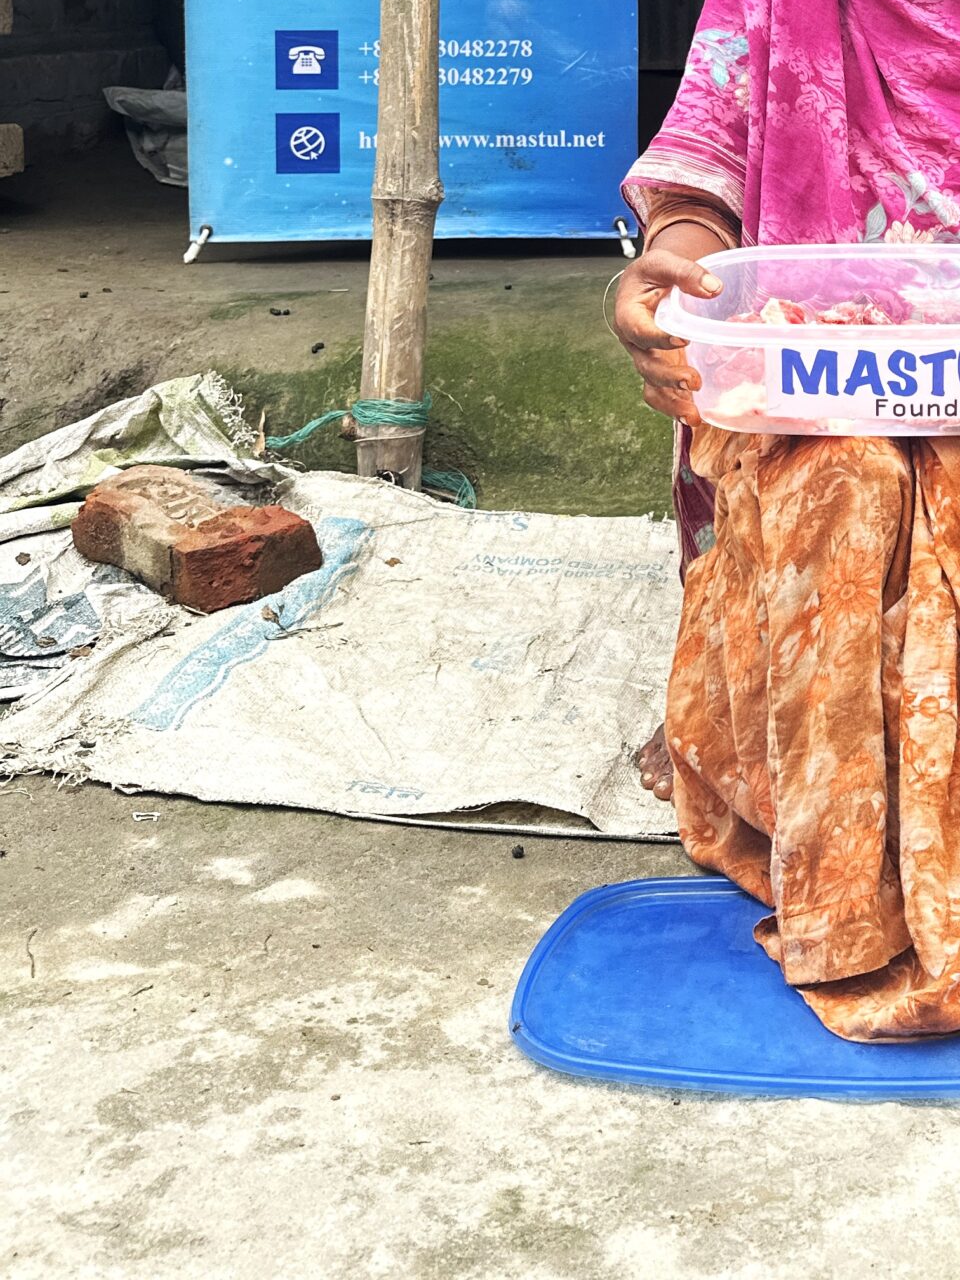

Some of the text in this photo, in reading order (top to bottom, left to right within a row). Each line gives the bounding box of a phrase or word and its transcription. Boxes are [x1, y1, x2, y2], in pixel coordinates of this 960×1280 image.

[358, 39, 533, 59] +830482278
[358, 67, 533, 86] +830482279
[472, 554, 562, 567] COMPANY
